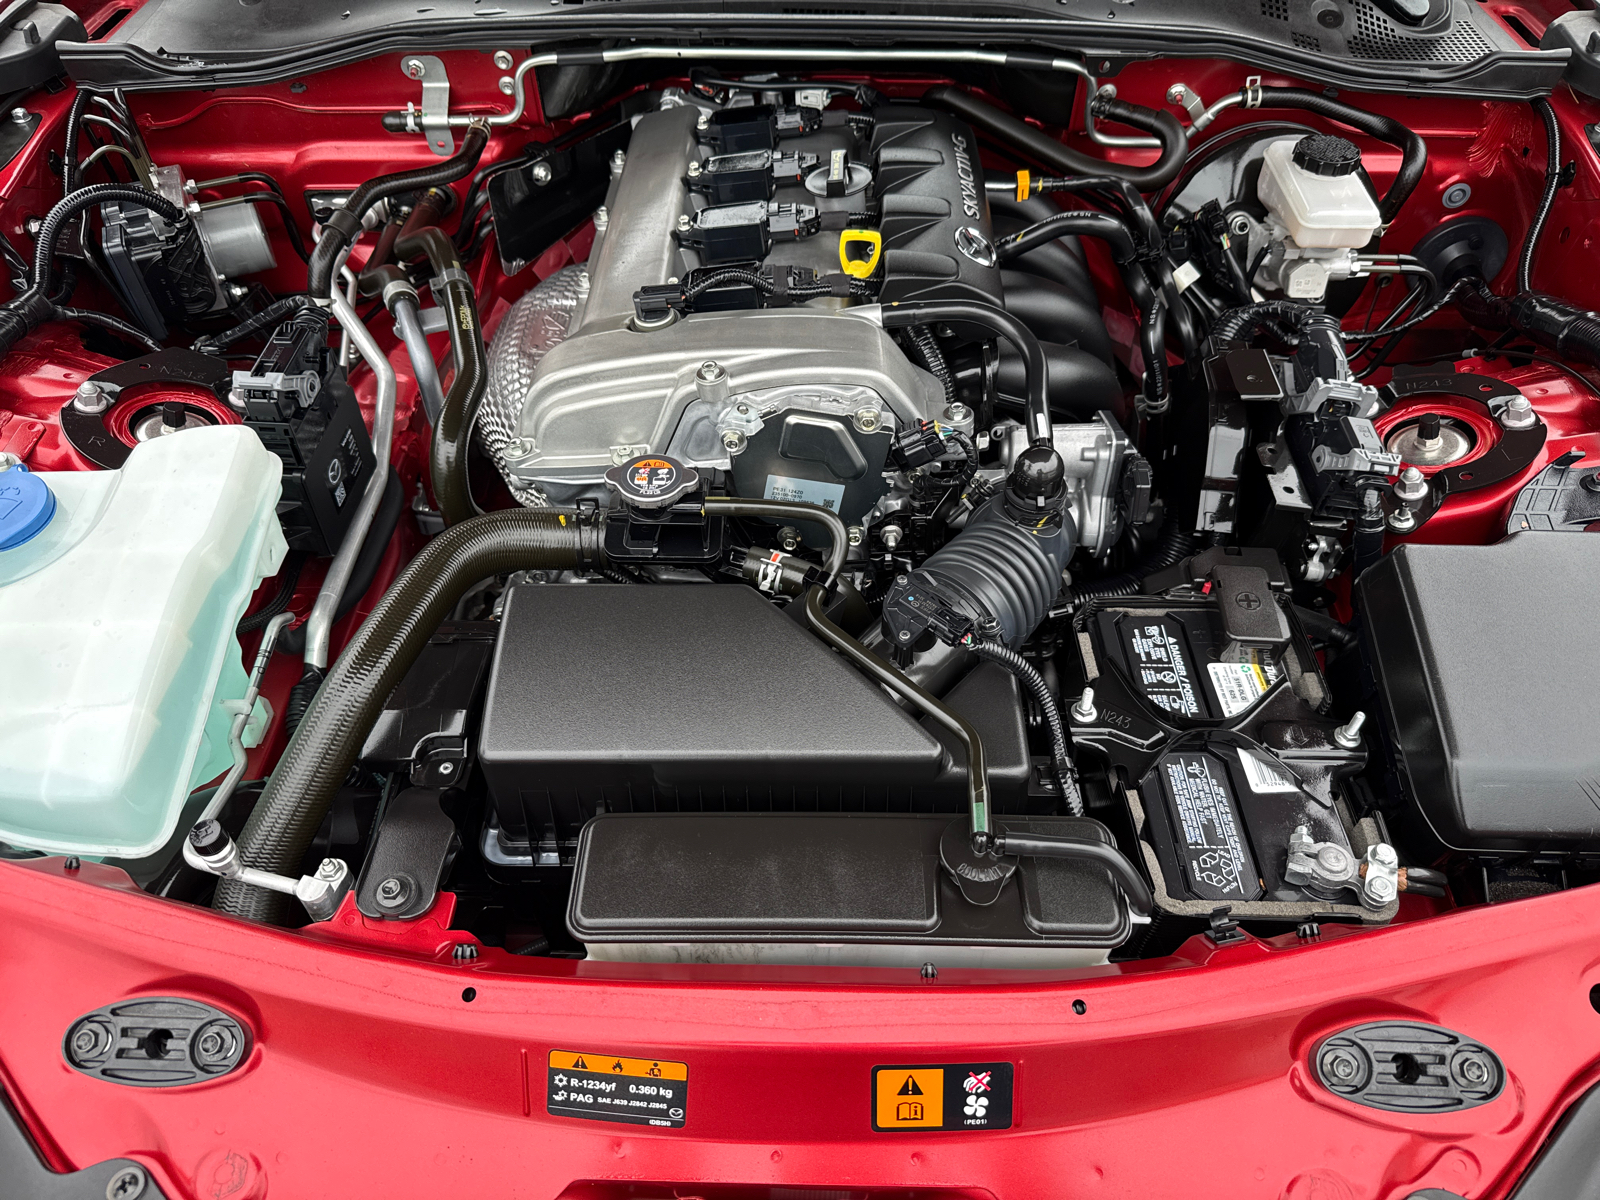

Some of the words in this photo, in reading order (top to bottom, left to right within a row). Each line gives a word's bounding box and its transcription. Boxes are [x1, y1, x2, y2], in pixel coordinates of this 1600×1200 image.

[952, 132, 980, 220] SKYACTIV-G
[1406, 378, 1452, 390] N243
[88, 436, 106, 446] R
[1170, 644, 1187, 676] DANGER
[1182, 683, 1199, 713] POISON
[1100, 709, 1132, 728] N243
[1188, 778, 1199, 797] MEDICAL
[1194, 798, 1202, 810] HELP
[1198, 812, 1207, 824] FAST
[1218, 850, 1230, 858] LEAD
[957, 863, 1003, 882] COOLANT
[1192, 860, 1202, 881] RECYCLE
[570, 1078, 616, 1093] R-1234yf
[629, 1084, 657, 1095] 0.360
[659, 1087, 673, 1099] kg
[570, 1092, 594, 1103] PAG
[648, 1101, 668, 1110] J2845
